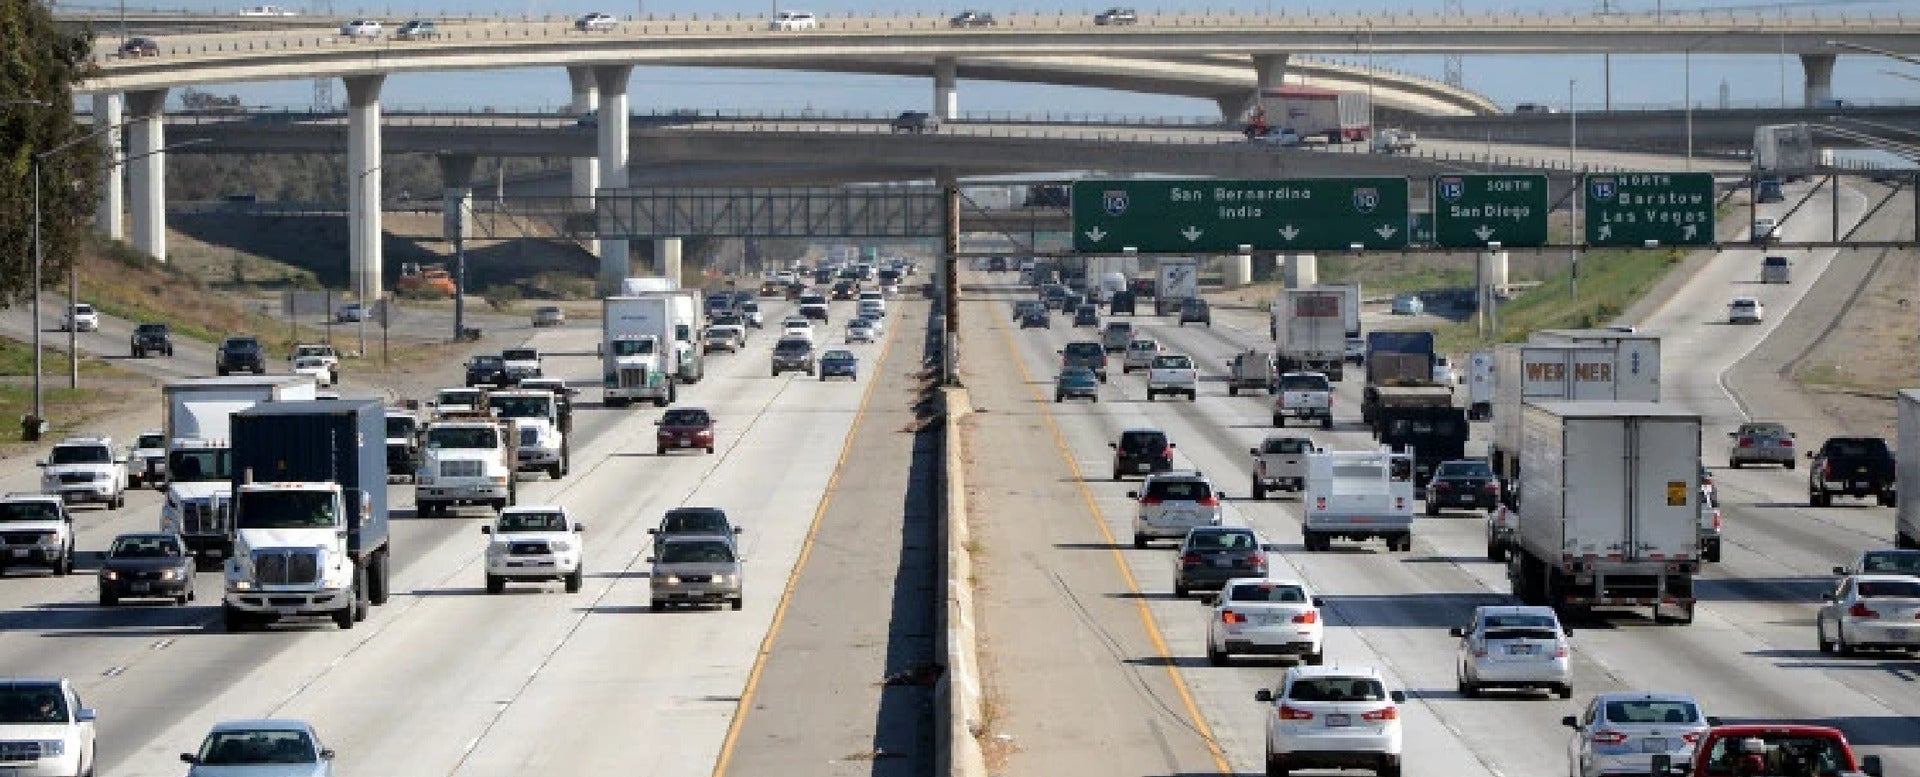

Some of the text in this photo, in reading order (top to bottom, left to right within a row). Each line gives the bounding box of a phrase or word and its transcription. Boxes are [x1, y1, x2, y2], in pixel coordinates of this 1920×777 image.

[1487, 180, 1532, 192] SOUTH
[1619, 175, 1671, 186] NORTH
[1171, 187, 1311, 201] San Bernardino
[1444, 184, 1462, 197] 15
[1596, 184, 1612, 197] 15
[1618, 191, 1703, 204] Barstow
[1450, 204, 1530, 222] San Diego
[1602, 209, 1706, 227] Las Vegas
